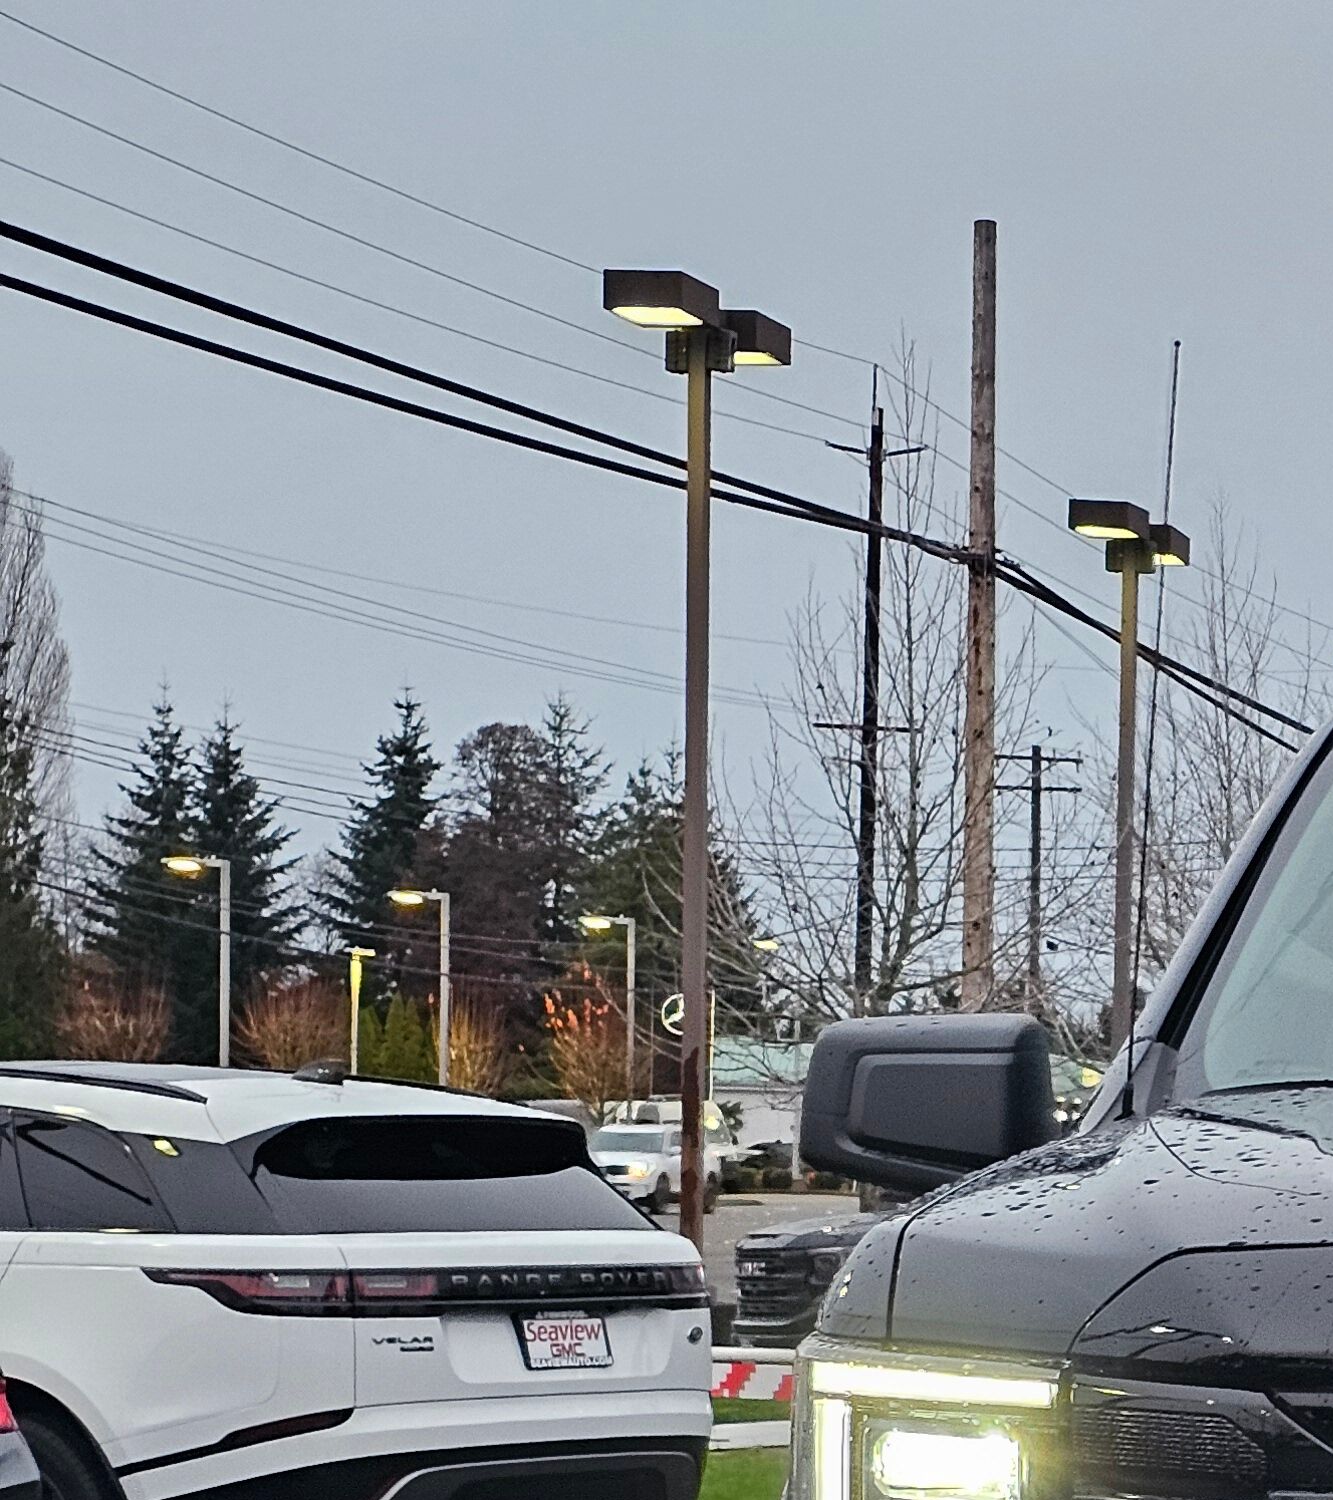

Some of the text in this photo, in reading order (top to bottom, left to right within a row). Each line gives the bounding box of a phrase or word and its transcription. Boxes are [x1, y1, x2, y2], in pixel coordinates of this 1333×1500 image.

[451, 1271, 668, 1287] RANGE ROVER
[525, 1320, 601, 1342] Seaview
[550, 1342, 585, 1357] GMC
